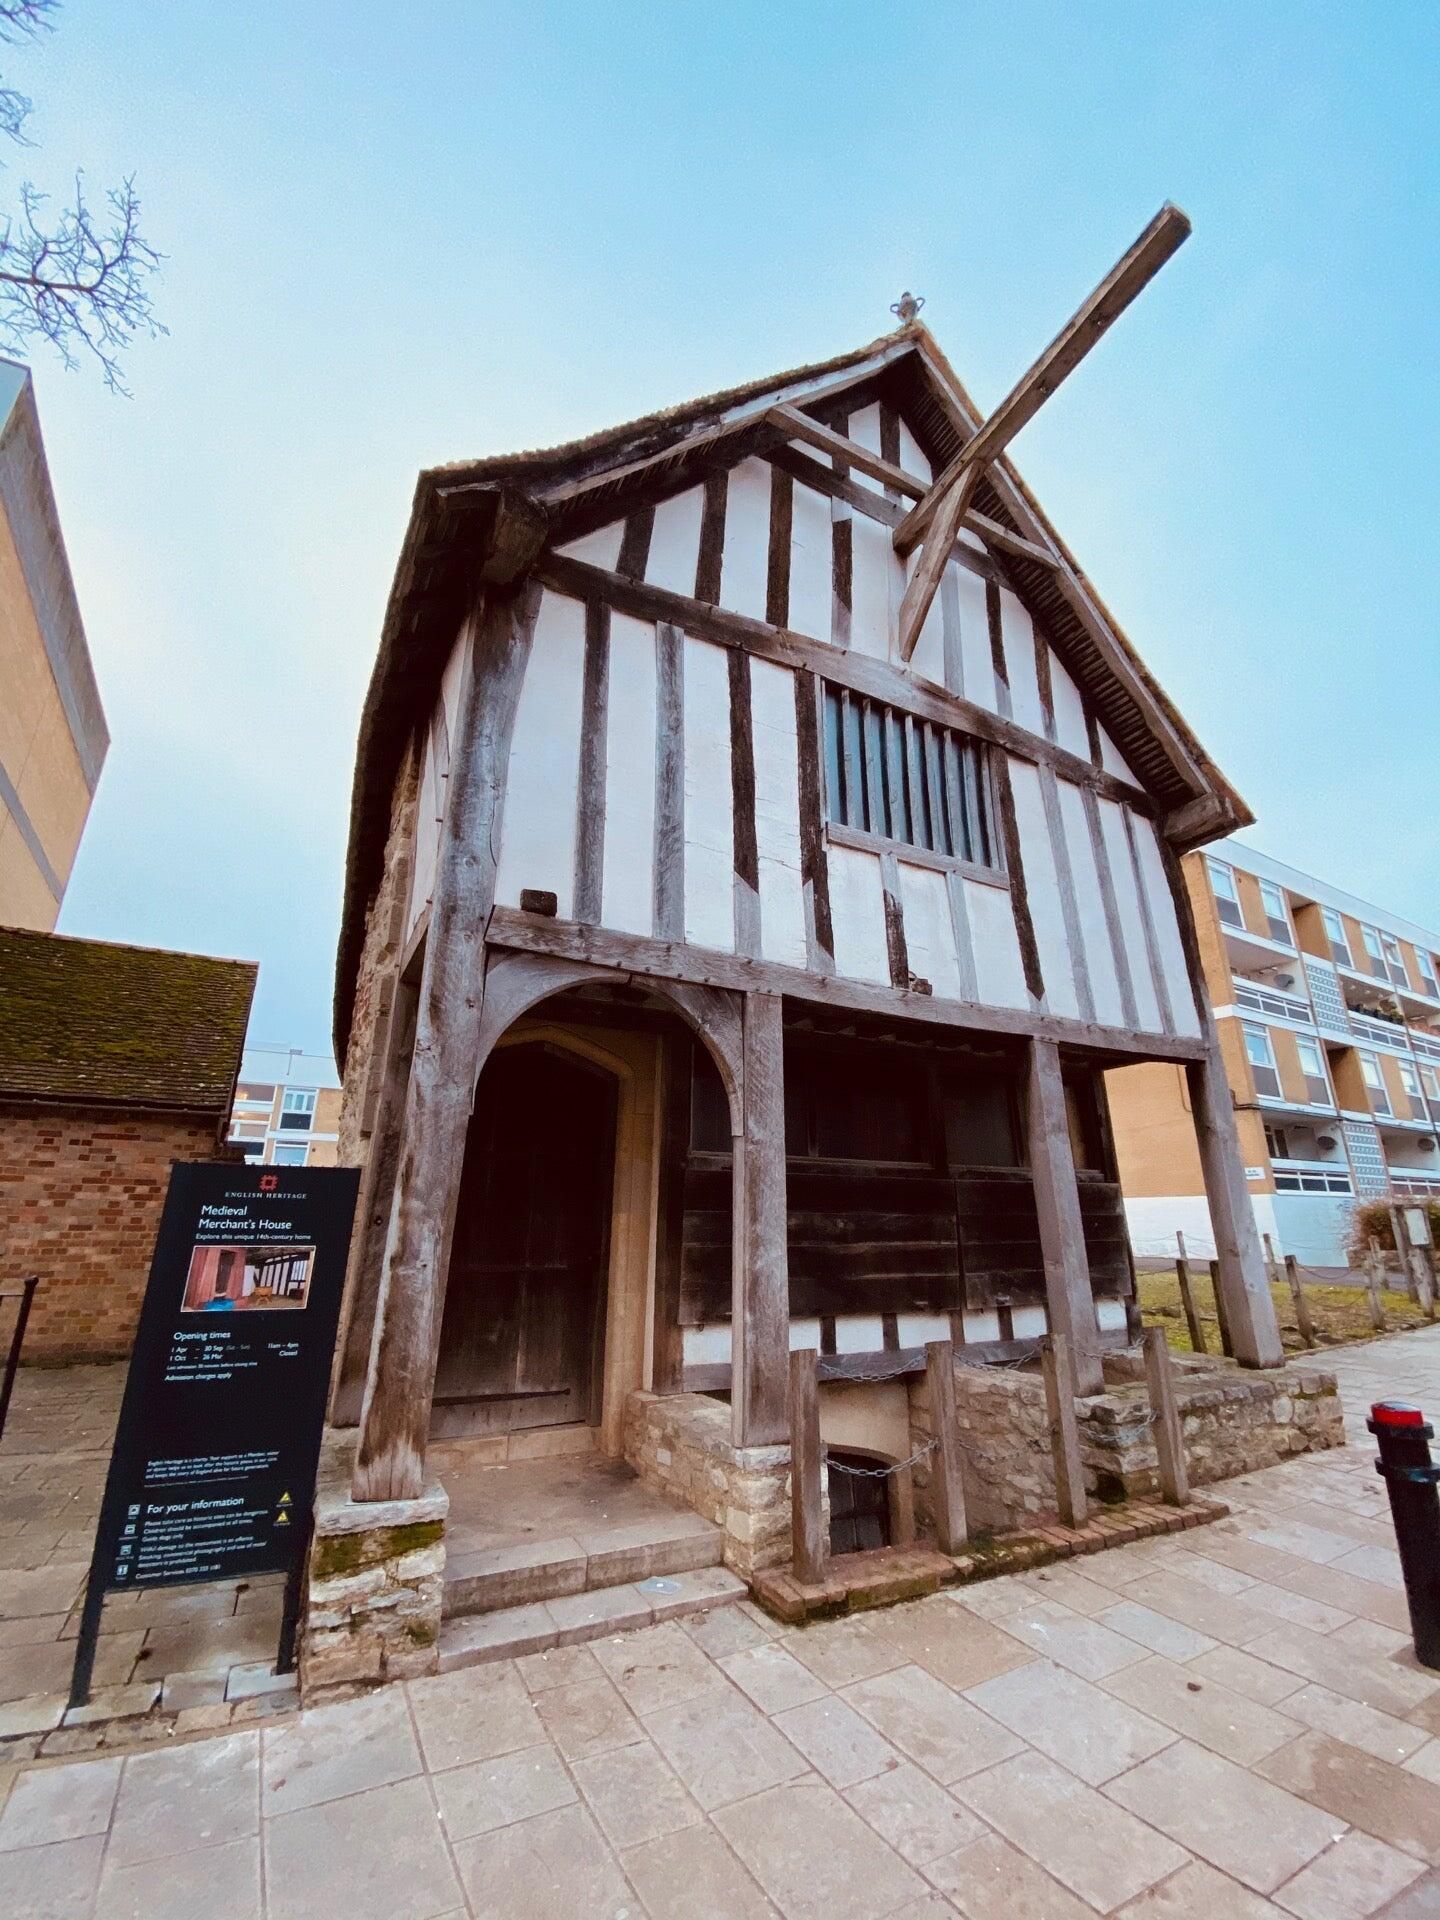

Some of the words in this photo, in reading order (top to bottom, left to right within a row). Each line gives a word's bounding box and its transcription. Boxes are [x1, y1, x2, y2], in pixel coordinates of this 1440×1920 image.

[201, 1205, 248, 1216] Medieval
[199, 1219, 256, 1229] Merchant's
[259, 1219, 292, 1230] House
[173, 1332, 207, 1341] Opening
[147, 1504, 164, 1514] For
[166, 1503, 189, 1515] your
[191, 1497, 245, 1510] information
